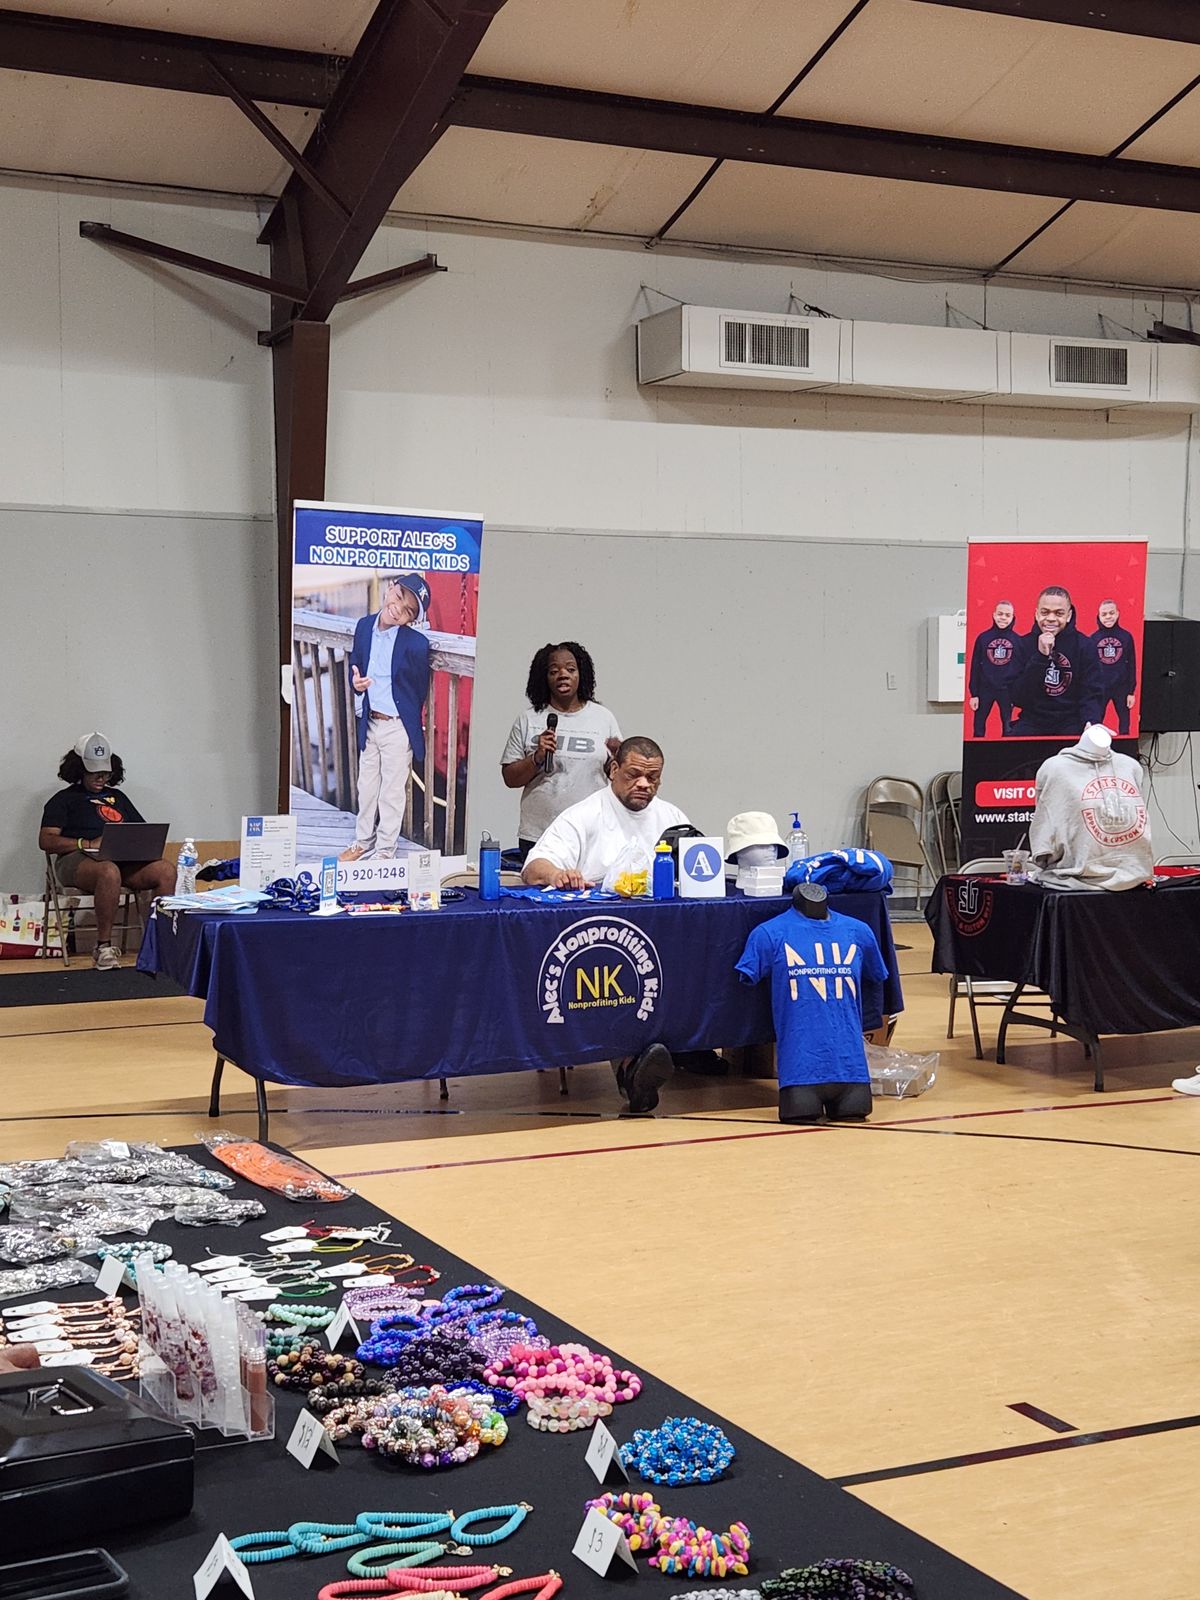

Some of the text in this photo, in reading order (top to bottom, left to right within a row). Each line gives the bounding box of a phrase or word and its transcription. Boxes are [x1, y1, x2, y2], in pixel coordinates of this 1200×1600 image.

[326, 526, 456, 549] SUPPORT ALEC'S
[310, 546, 469, 571] NONPROFITING KIDS
[993, 786, 1036, 799] VISIT O
[1086, 778, 1136, 796] STATS UP
[975, 811, 1035, 823] www.stats
[1110, 829, 1139, 843] CUSTOM
[690, 851, 715, 876] A
[319, 869, 348, 884] (5)
[352, 866, 405, 881] 920-1248
[542, 926, 658, 1023] Alec's Nonprofiting Kids
[788, 967, 852, 976] NONPROFITING KIDS
[576, 964, 624, 1000] NK
[568, 995, 636, 1010] Nonprofiting Kids
